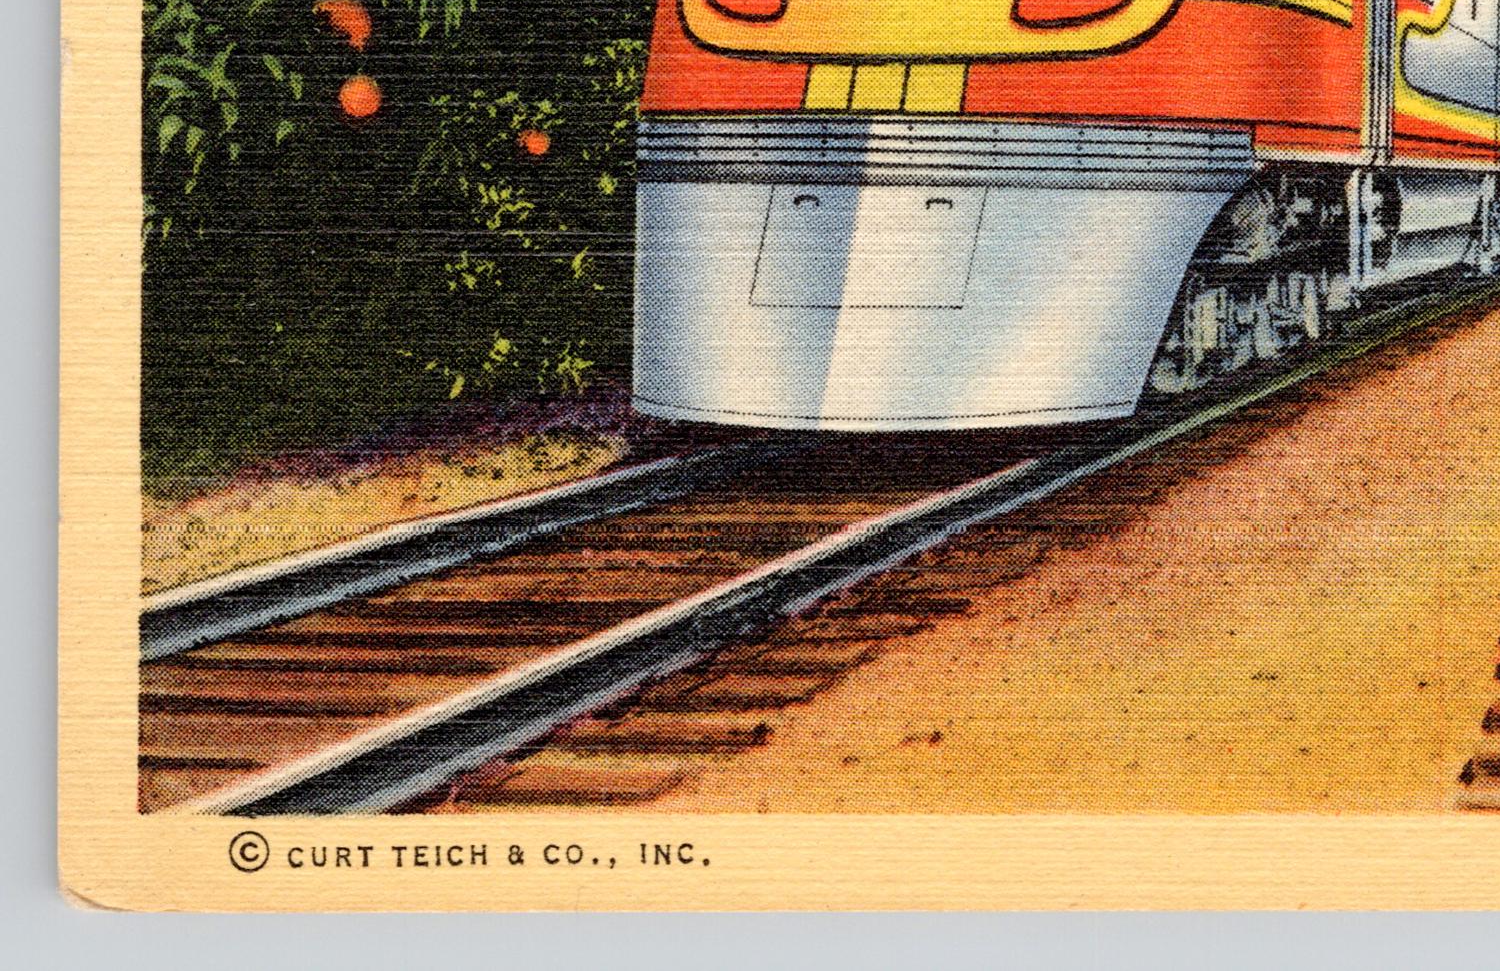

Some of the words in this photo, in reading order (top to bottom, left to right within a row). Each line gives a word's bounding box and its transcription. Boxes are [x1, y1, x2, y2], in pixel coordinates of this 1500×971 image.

[287, 845, 374, 869] CURT
[391, 844, 487, 868] TEICH
[508, 844, 524, 866] &
[543, 844, 616, 870] CO.,
[640, 843, 711, 867] INC.
